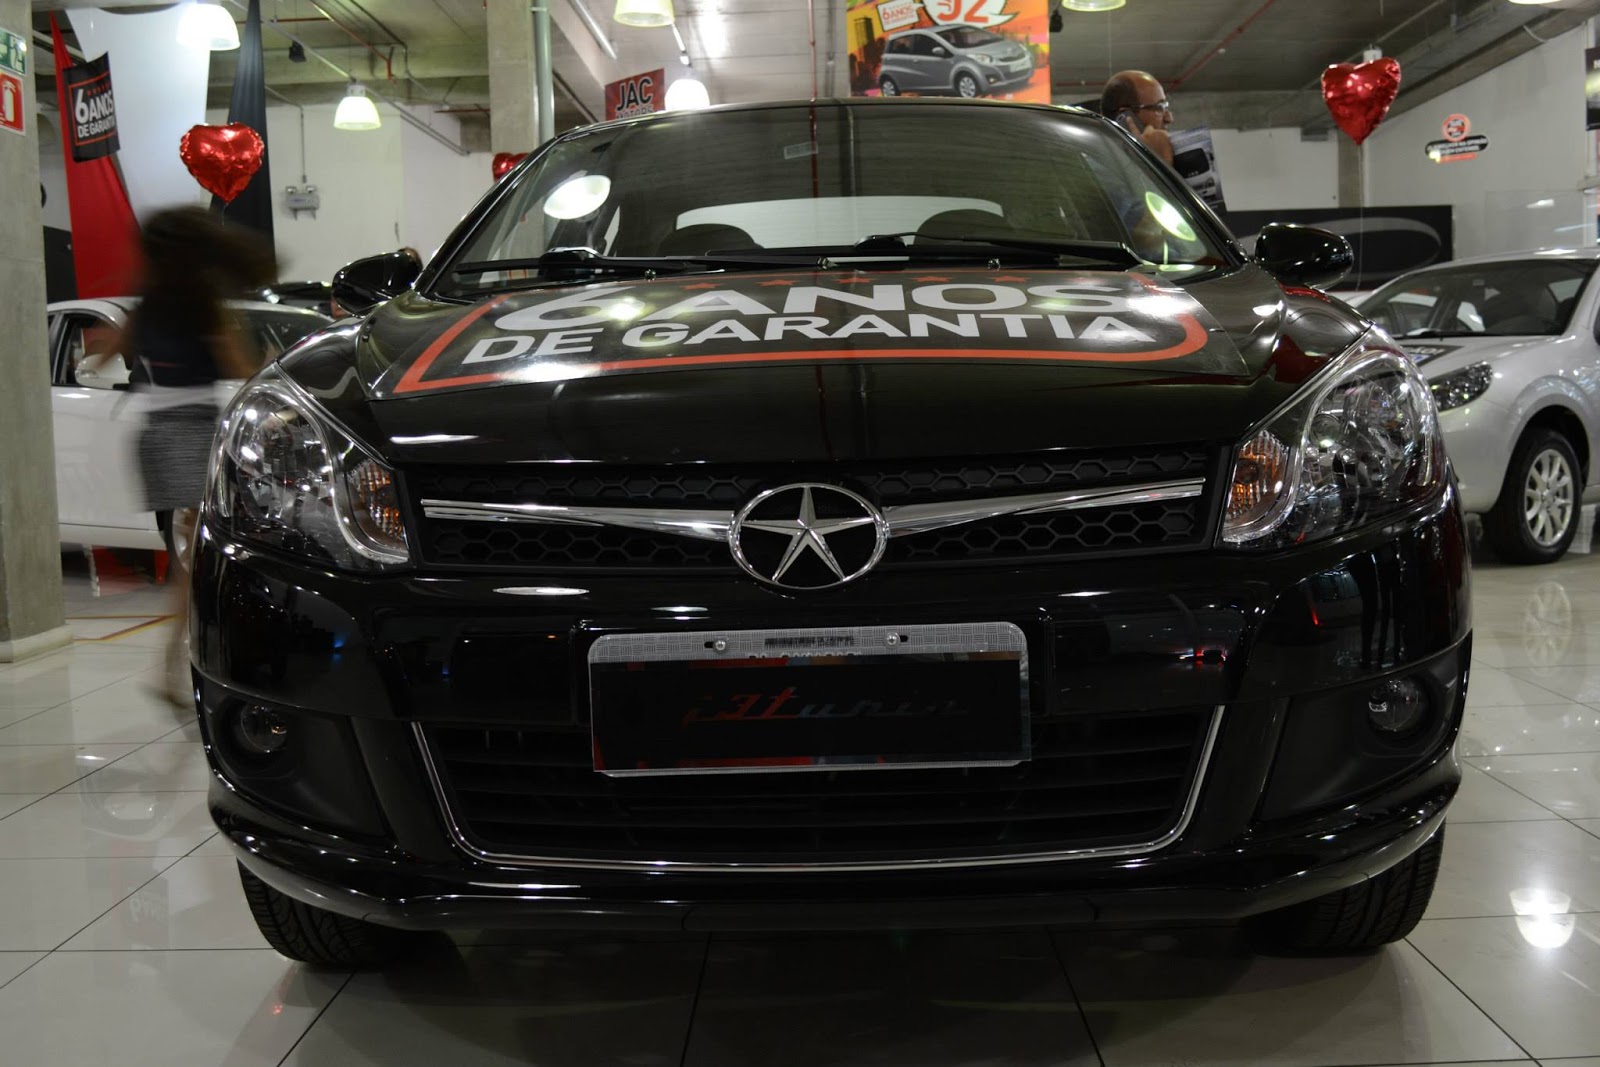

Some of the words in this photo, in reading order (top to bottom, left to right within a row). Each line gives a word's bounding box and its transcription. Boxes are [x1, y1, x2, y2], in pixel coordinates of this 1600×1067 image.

[75, 88, 90, 125] 6
[615, 75, 654, 111] JAC
[77, 124, 91, 139] DE
[494, 284, 646, 332] 6
[640, 282, 1131, 323] ANOS
[461, 327, 604, 365] DE
[621, 313, 1157, 348] GARANTIA
